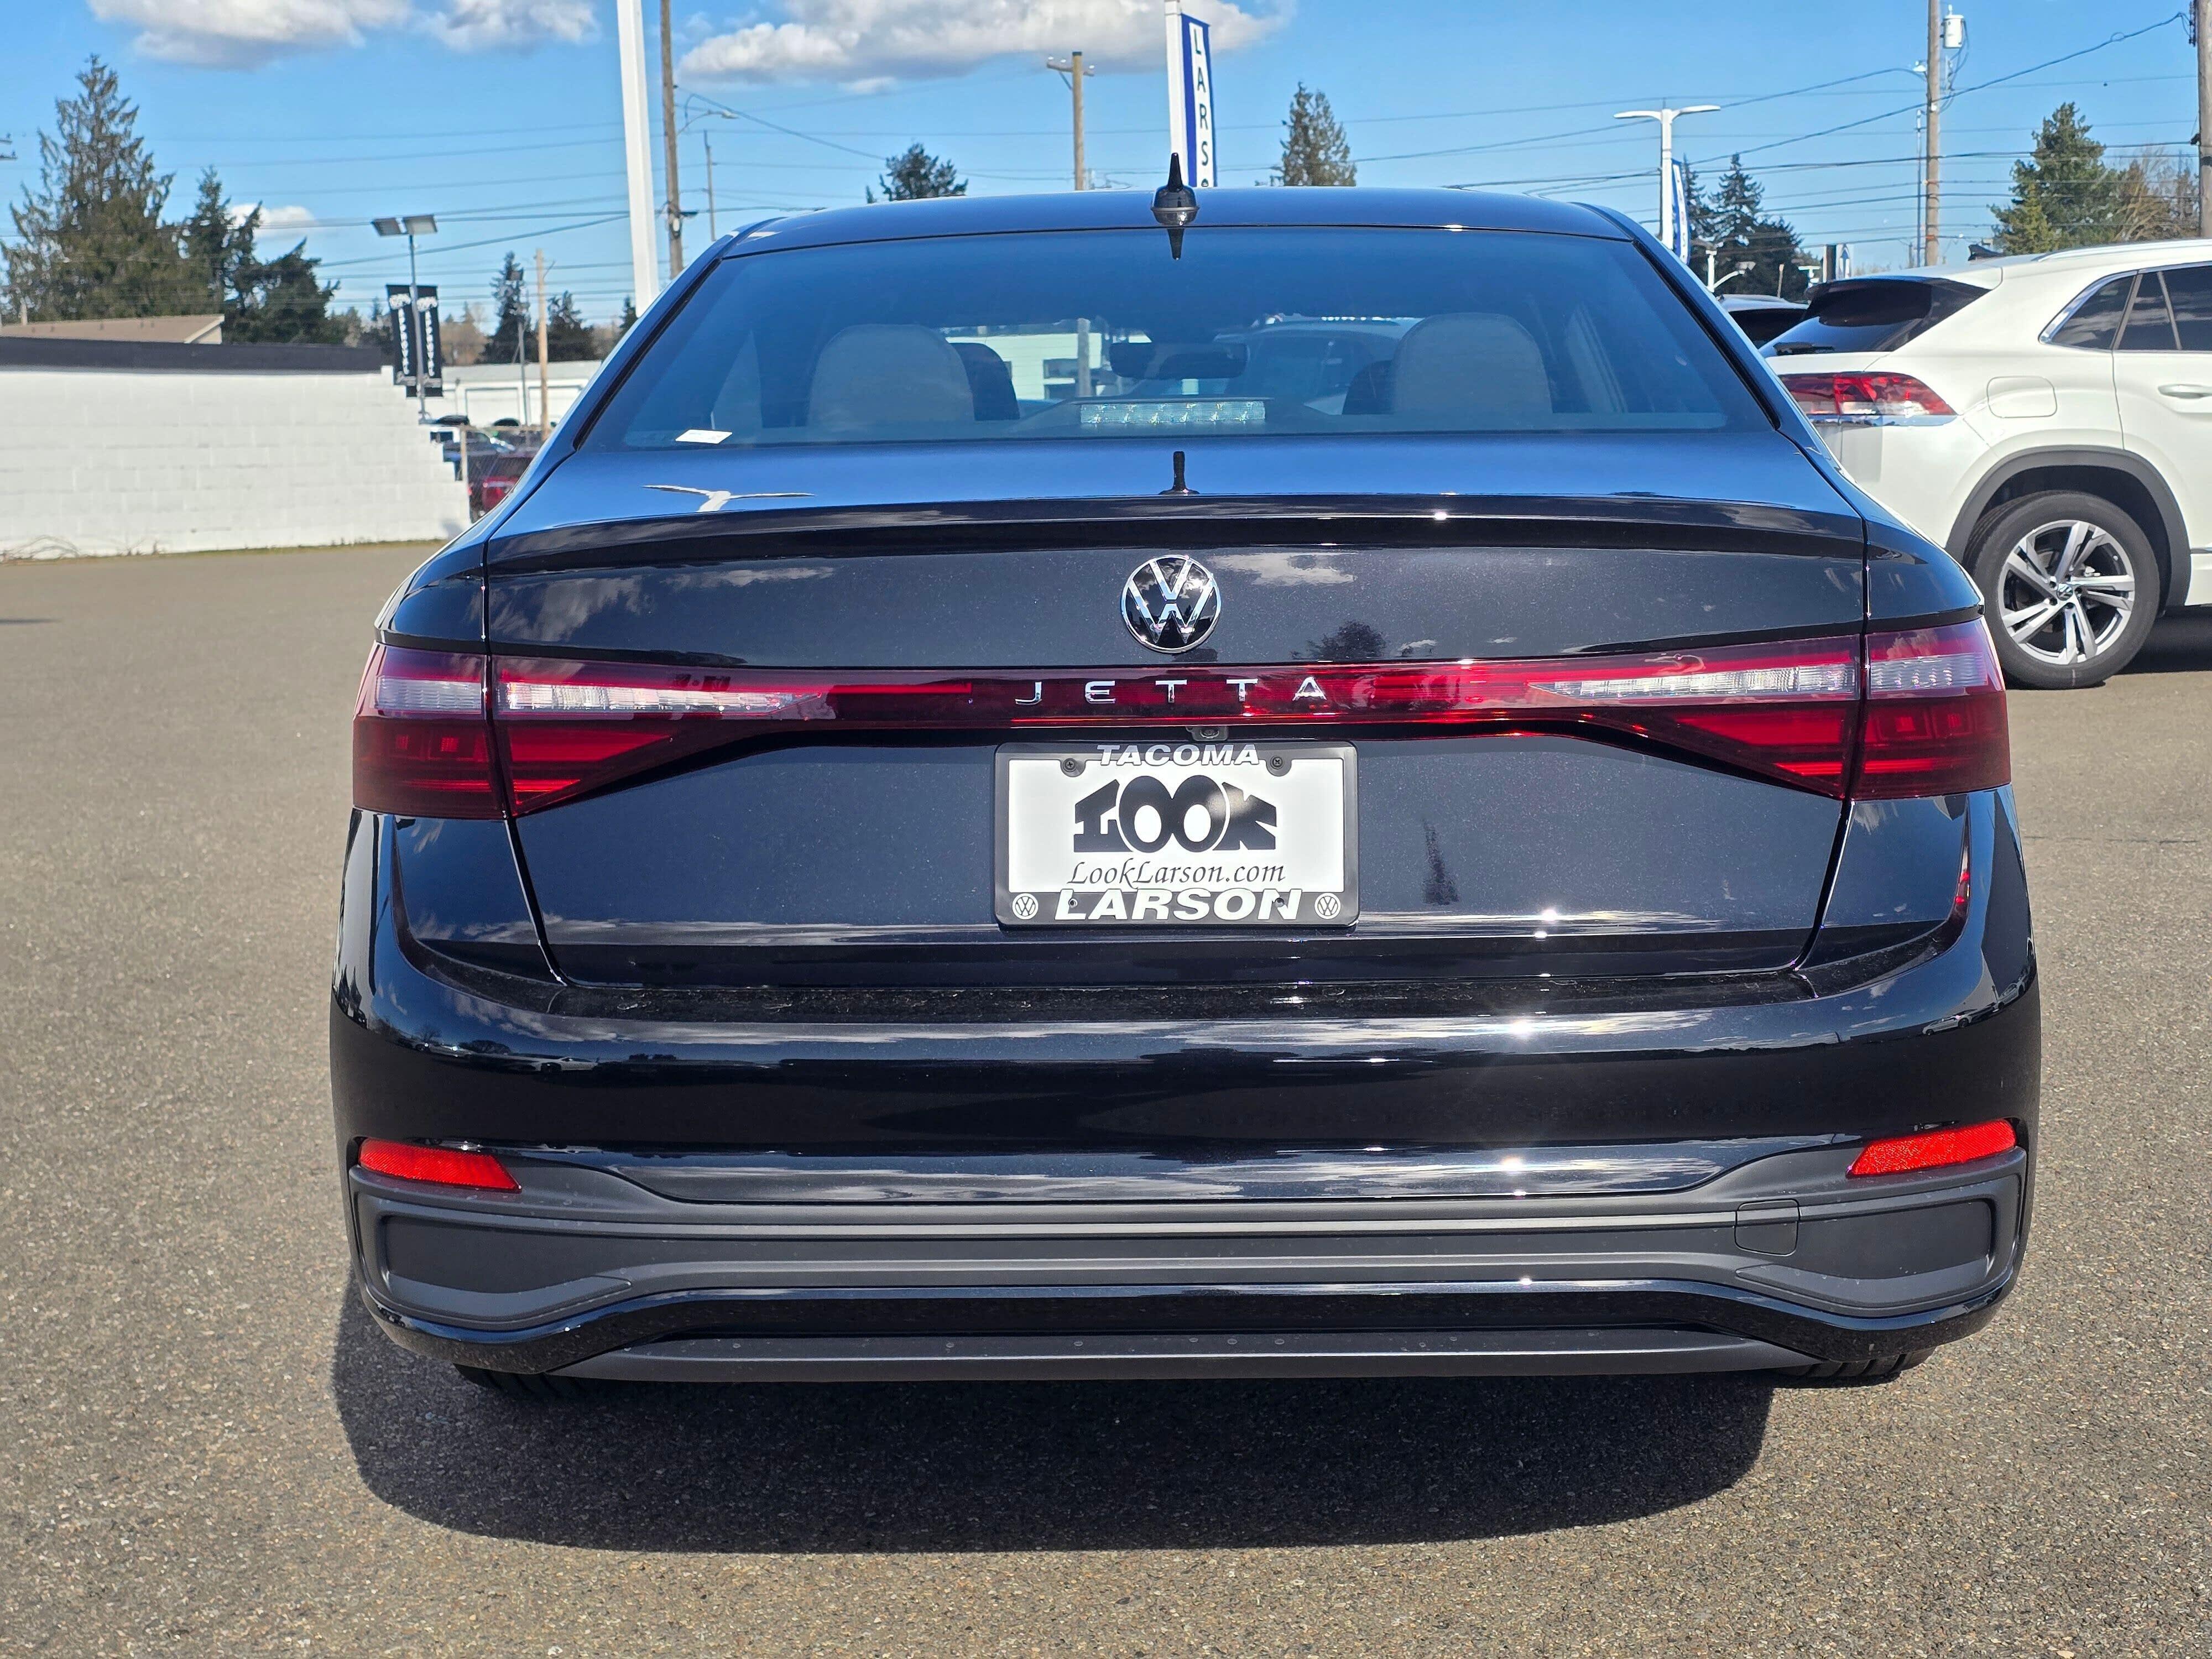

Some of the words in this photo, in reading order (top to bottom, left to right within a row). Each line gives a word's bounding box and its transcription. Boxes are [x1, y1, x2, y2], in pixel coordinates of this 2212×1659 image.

[1124, 556, 1218, 645] VW
[1015, 676, 1327, 706] JETTA
[1097, 744, 1260, 766] TACOMA
[1067, 858, 1286, 890] LookLarson.com
[1054, 888, 1302, 921] LARSON
